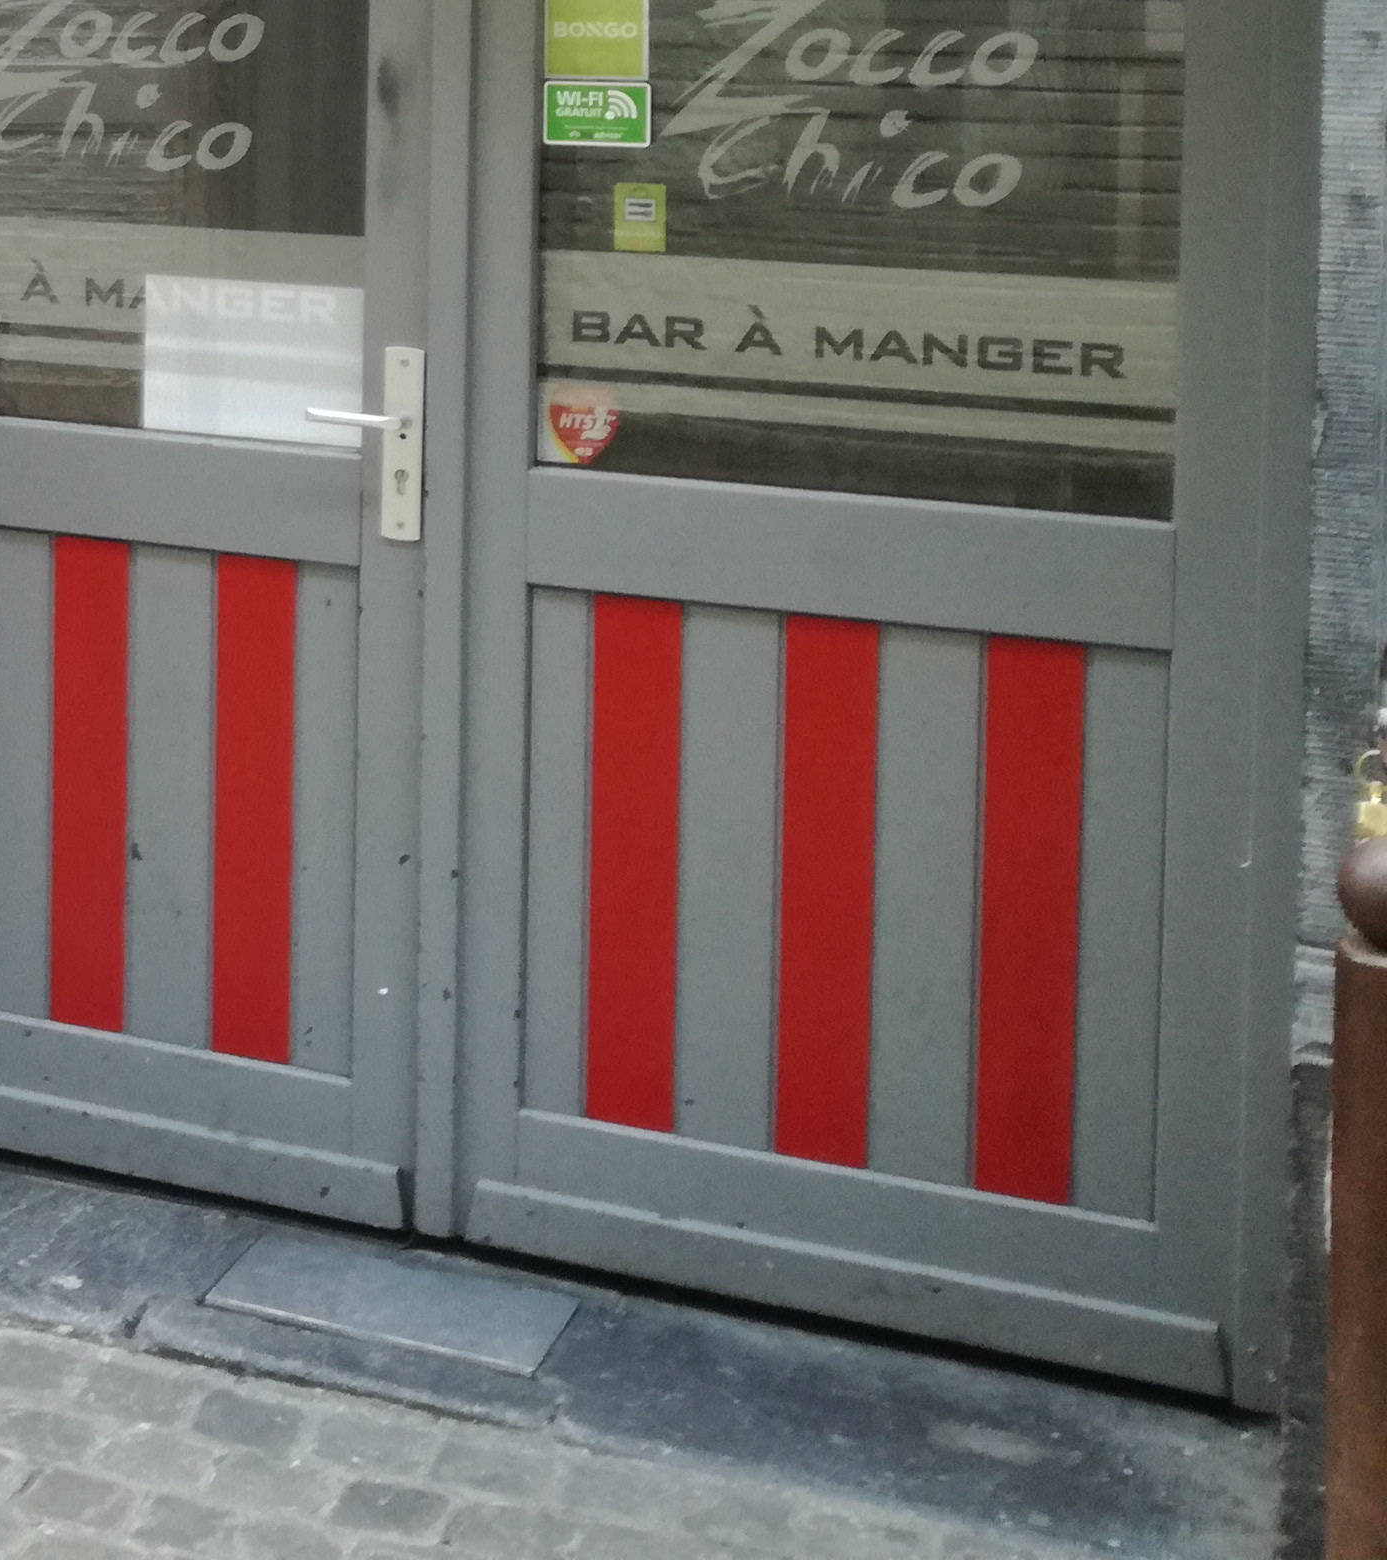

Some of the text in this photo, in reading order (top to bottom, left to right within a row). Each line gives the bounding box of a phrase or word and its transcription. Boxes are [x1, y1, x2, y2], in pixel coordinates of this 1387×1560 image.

[553, 20, 638, 39] BONGO
[555, 90, 604, 107] WI-FI
[555, 107, 603, 118] GRATUIT
[20, 258, 59, 306] À
[84, 277, 338, 324] MANGER
[570, 304, 1128, 380] BAR À MANGER
